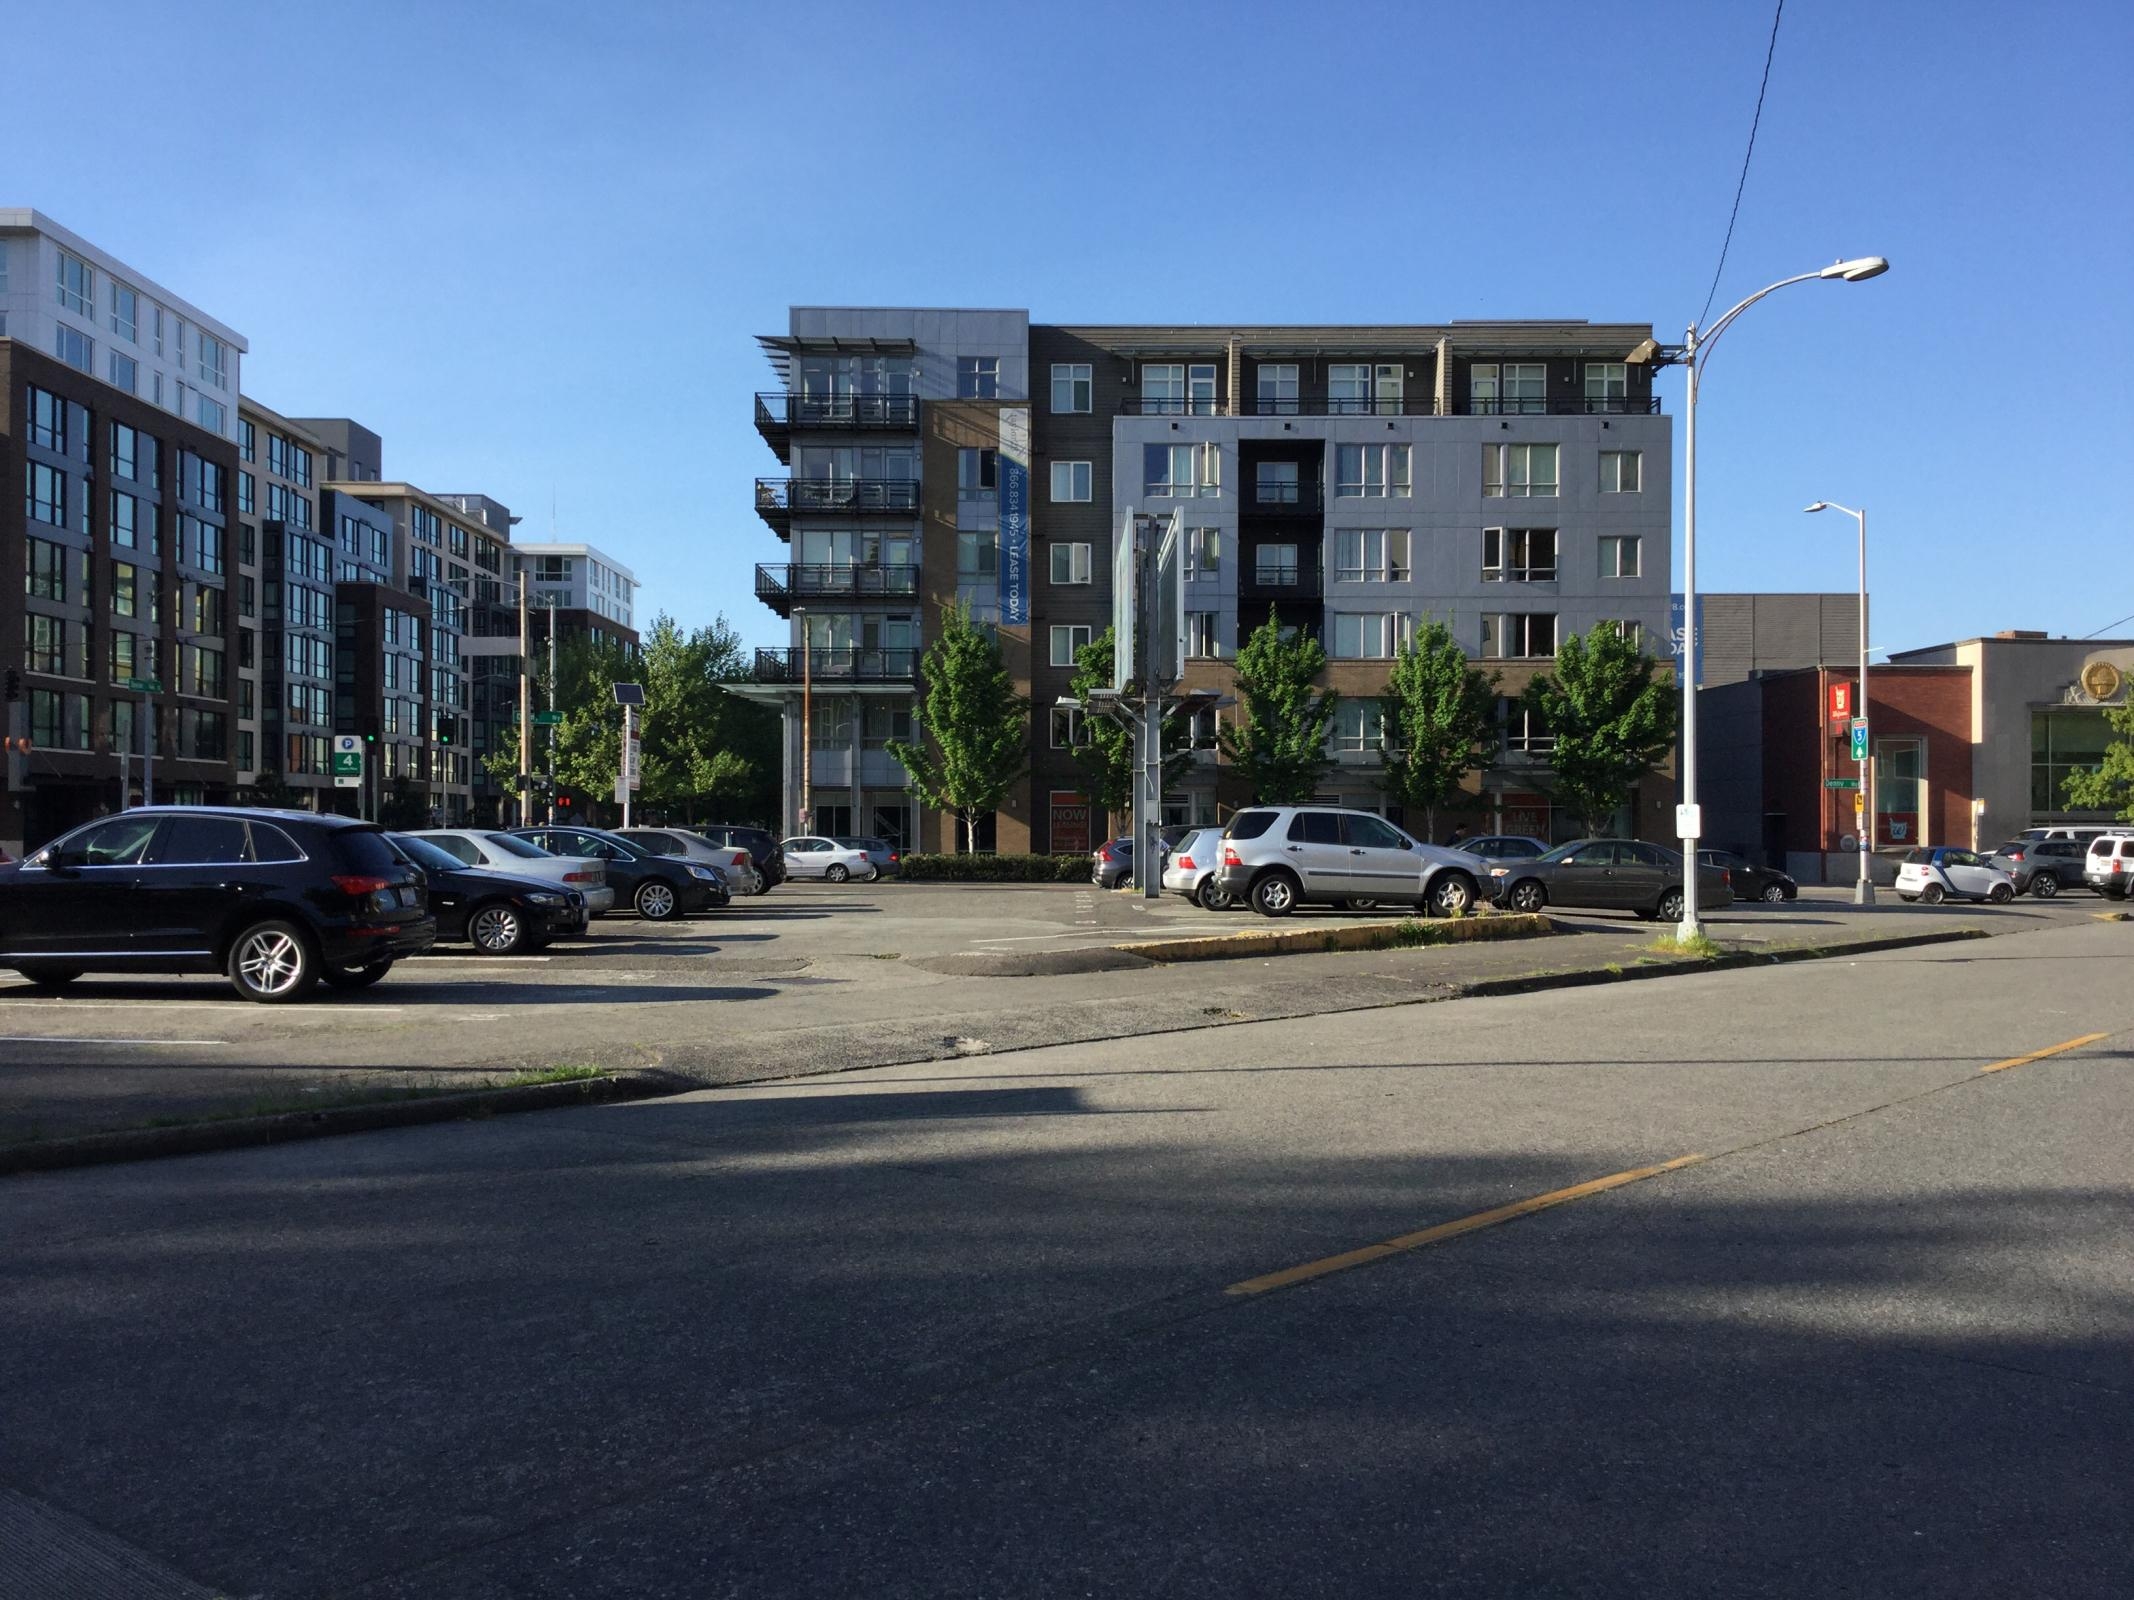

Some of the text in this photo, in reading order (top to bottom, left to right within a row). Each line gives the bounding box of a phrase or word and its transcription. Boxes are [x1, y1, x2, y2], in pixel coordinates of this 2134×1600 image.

[1009, 546, 1019, 580] LEASE
[1009, 583, 1019, 621] TODAY
[1857, 731, 1863, 741] 5
[344, 740, 352, 748] P
[343, 754, 353, 766] 4
[1053, 808, 1087, 820] NOW
[1505, 824, 1545, 835] GREEN
